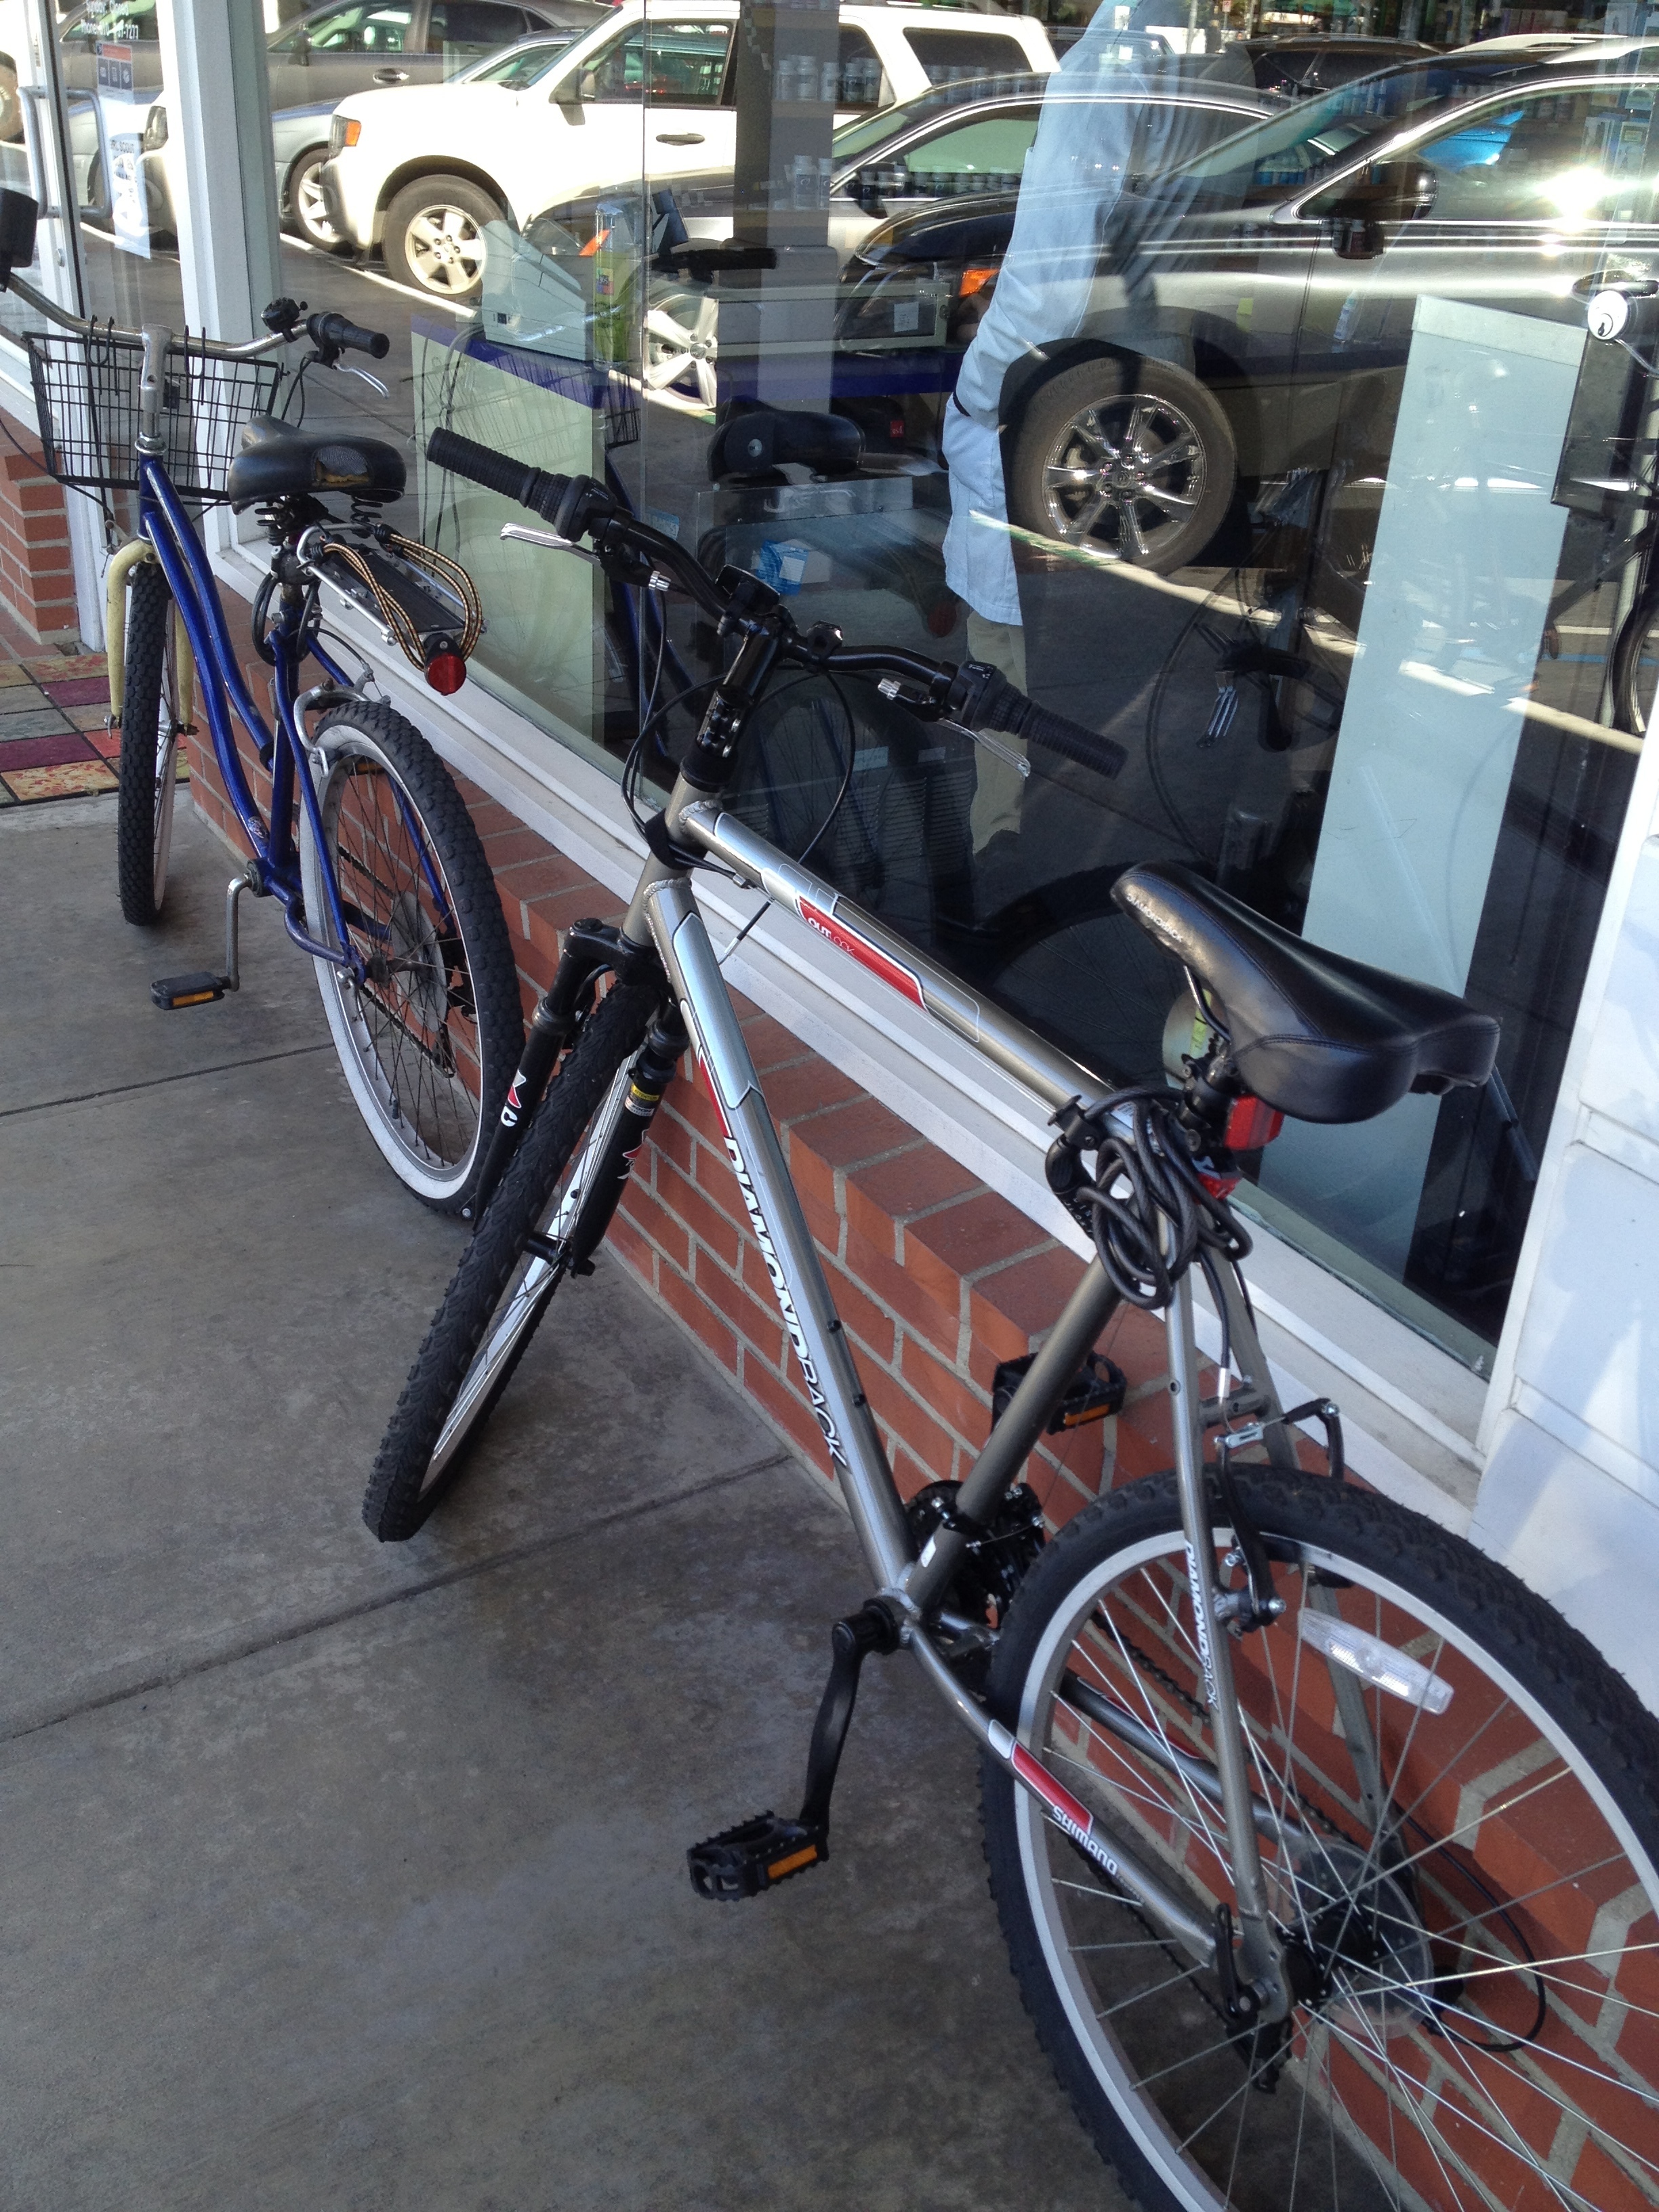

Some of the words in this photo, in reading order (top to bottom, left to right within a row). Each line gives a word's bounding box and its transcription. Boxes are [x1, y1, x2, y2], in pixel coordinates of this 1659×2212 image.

[724, 1135, 847, 1468] DIAMONDBACK
[1185, 1540, 1219, 1711] DIAMONDBACK
[1052, 1805, 1118, 1876] SHIMANO
